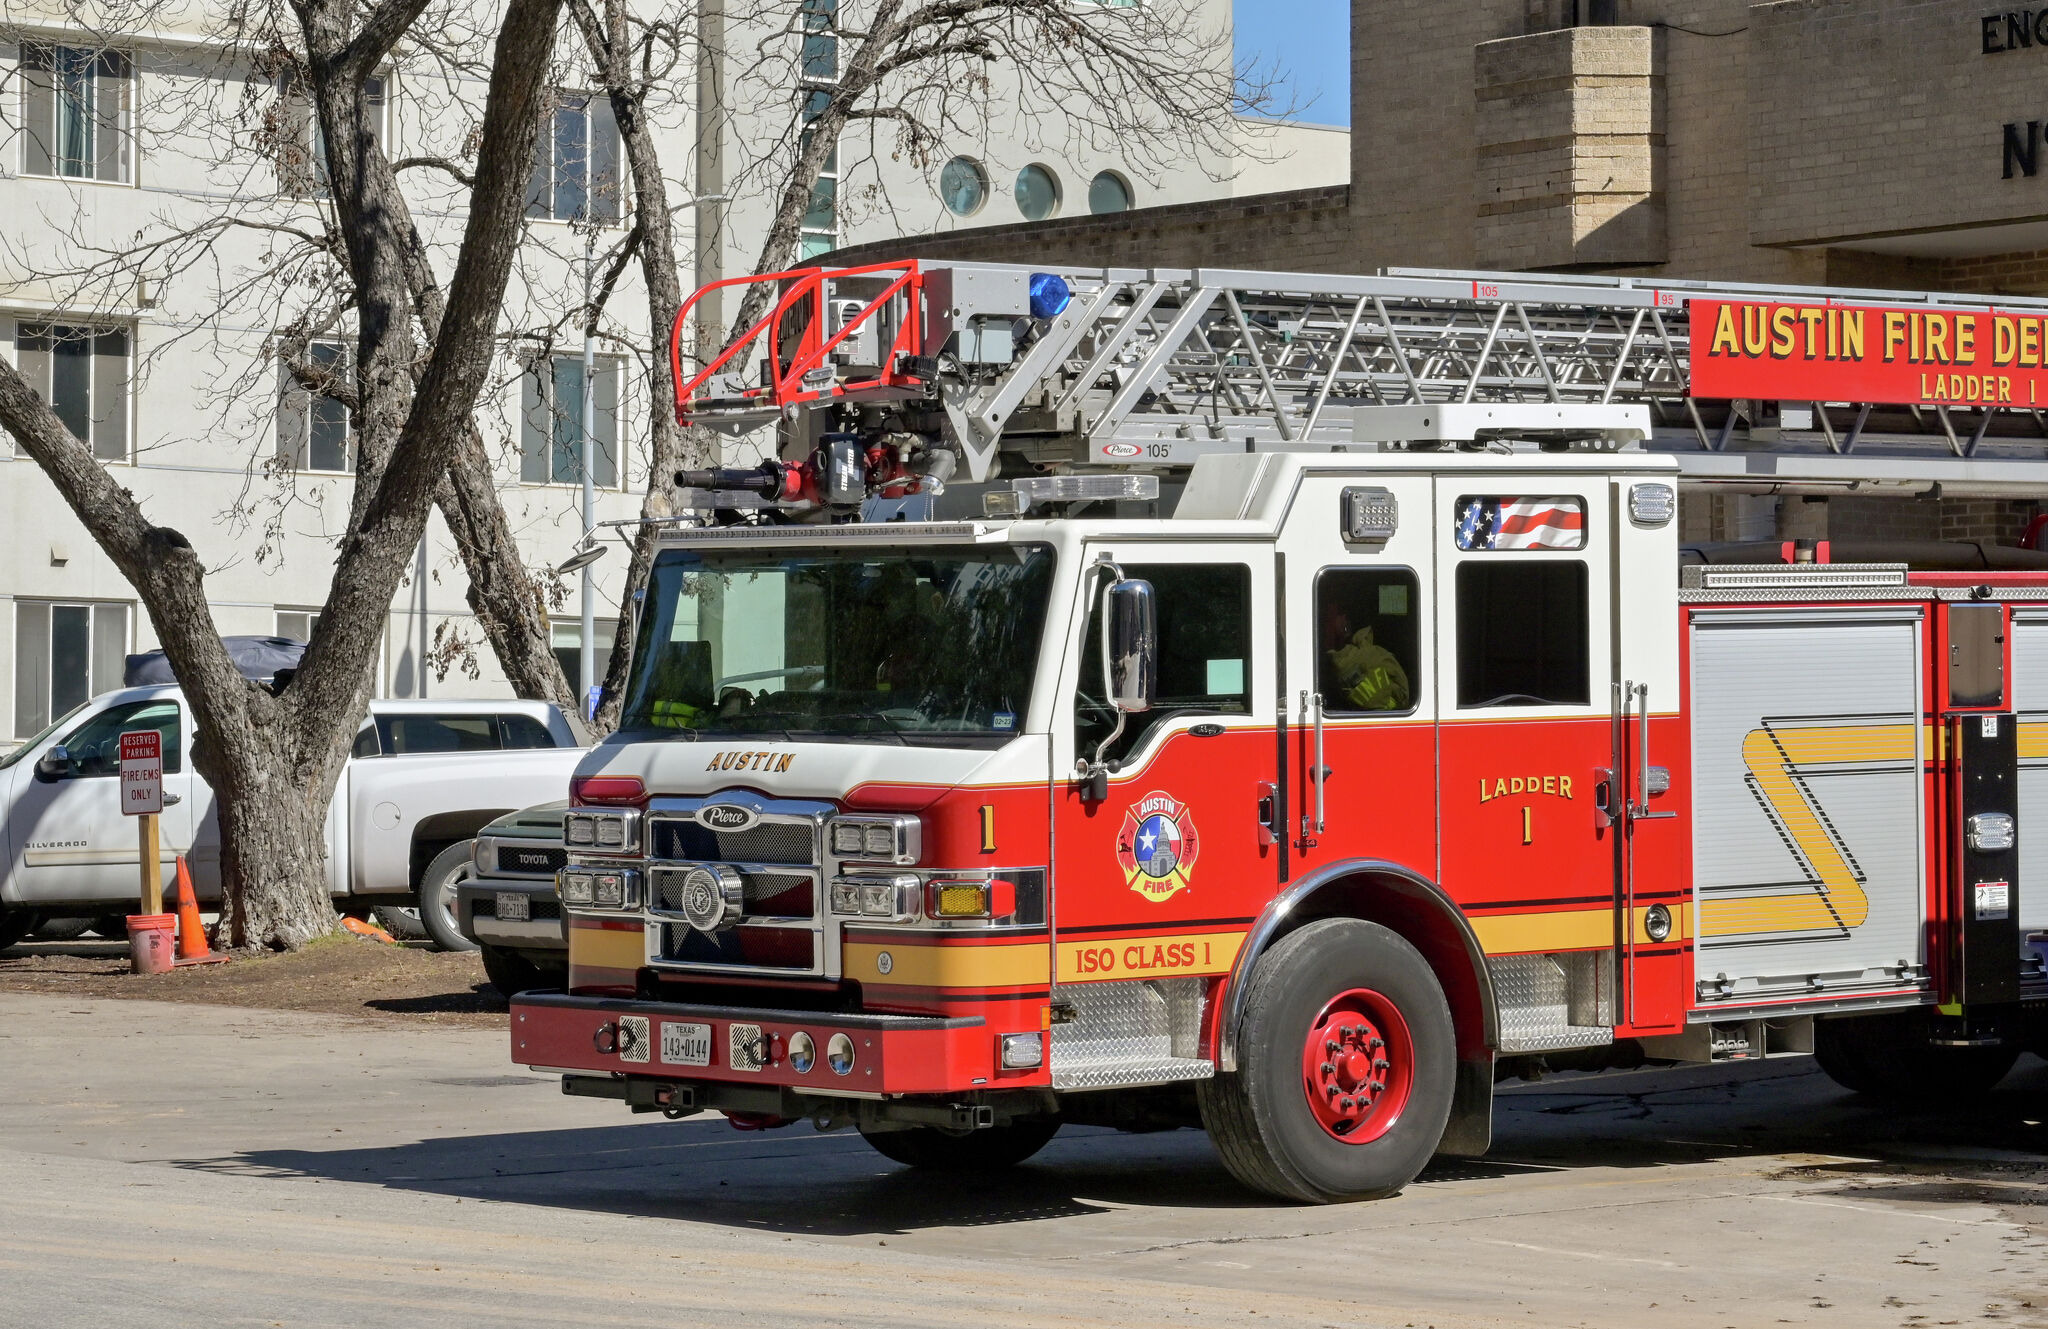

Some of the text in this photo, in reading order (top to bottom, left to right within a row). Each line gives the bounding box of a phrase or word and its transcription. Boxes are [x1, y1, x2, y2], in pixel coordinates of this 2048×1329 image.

[1481, 285, 1498, 297] 105
[1661, 294, 1674, 305] 95
[1708, 303, 2048, 369] AUSTIN FIRE DE
[1920, 373, 2012, 404] LADDER
[1111, 444, 1134, 455] Pierce
[123, 734, 157, 747] RESERVED
[126, 747, 155, 758] PARKING
[705, 751, 797, 773] AUSTIN
[122, 768, 159, 782] FIRE/EMS
[131, 788, 152, 801] ONLY
[1479, 775, 1574, 805] LADDER
[1140, 797, 1175, 816] AUSTIN
[709, 806, 745, 826] Pierce
[978, 804, 998, 855] 1
[1521, 806, 1533, 846] 1
[24, 840, 88, 849] SILVERADO
[519, 854, 549, 865] TOYOTA
[1143, 879, 1174, 893] FIRE
[1075, 942, 1212, 974] ISO CLASS 1
[676, 1025, 696, 1034] TEXAS
